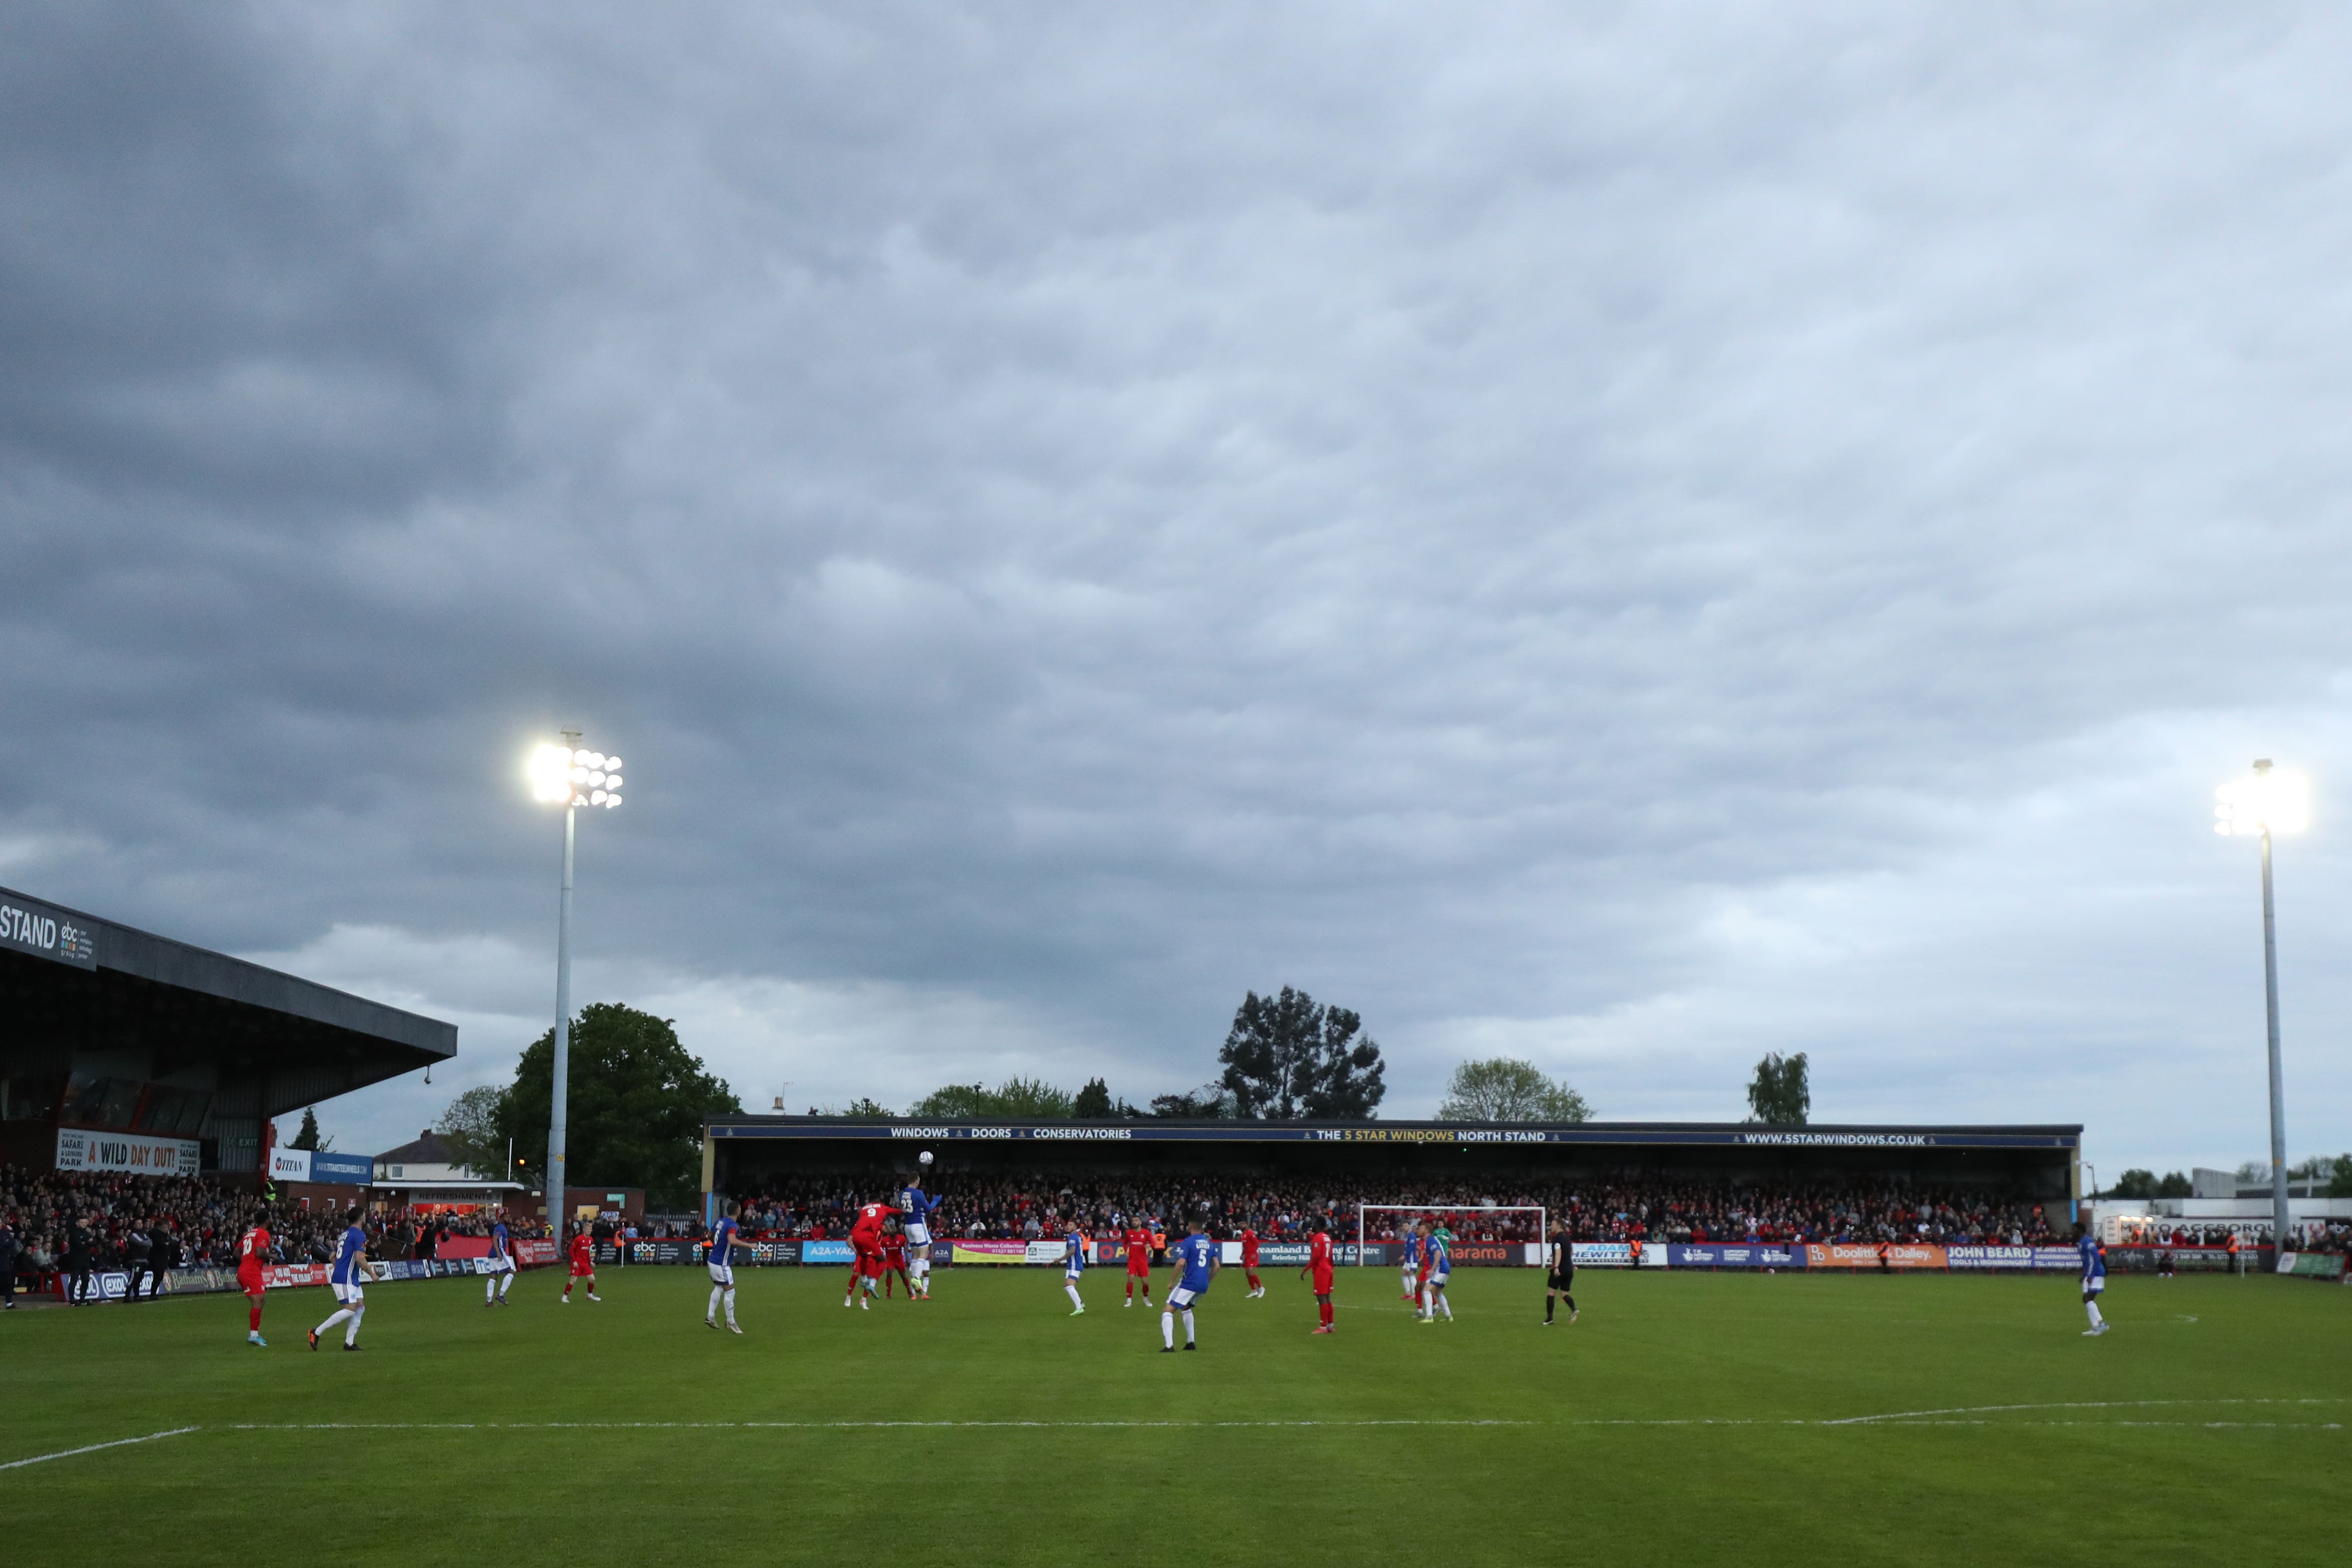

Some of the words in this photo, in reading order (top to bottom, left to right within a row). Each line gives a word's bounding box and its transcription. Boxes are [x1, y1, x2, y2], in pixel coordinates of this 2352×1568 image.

[0, 905, 56, 949] STAND
[61, 921, 77, 942] ebc
[891, 1128, 949, 1138] WINDOWS
[972, 1128, 1011, 1138] DOORS
[1033, 1128, 1132, 1139] CONSERVATORIES
[1317, 1130, 1341, 1140] THE
[1345, 1130, 1352, 1140] 5
[1356, 1131, 1386, 1140] STAR
[1390, 1131, 1455, 1140] WINDOWS
[1458, 1131, 1502, 1141] NORTH
[1505, 1131, 1546, 1141] STAND
[1745, 1133, 1926, 1145] WWW.5STARWINDOWS.CO.UK
[62, 1139, 83, 1150] SAFARI
[239, 1138, 258, 1147] EXIT
[88, 1141, 96, 1163] A
[101, 1142, 127, 1165] WILD
[131, 1145, 150, 1167] DAY
[154, 1146, 175, 1168] OUT!
[180, 1149, 197, 1158] SAFARI
[60, 1158, 81, 1167] PARK
[281, 1160, 303, 1172] TITAN
[901, 1198, 914, 1213] 23
[867, 1207, 877, 1217] 9
[242, 1237, 252, 1256] 10
[336, 1240, 345, 1260] 6
[634, 1241, 656, 1252] ebc
[810, 1247, 856, 1255] A2A-YAC
[1257, 1245, 1302, 1253] reamland
[1198, 1249, 1207, 1267] 5
[1896, 1247, 1932, 1261] Dalley.
[1948, 1247, 1984, 1258] JOHN
[1987, 1247, 2032, 1258] BEARD
[105, 1277, 127, 1293] exol
